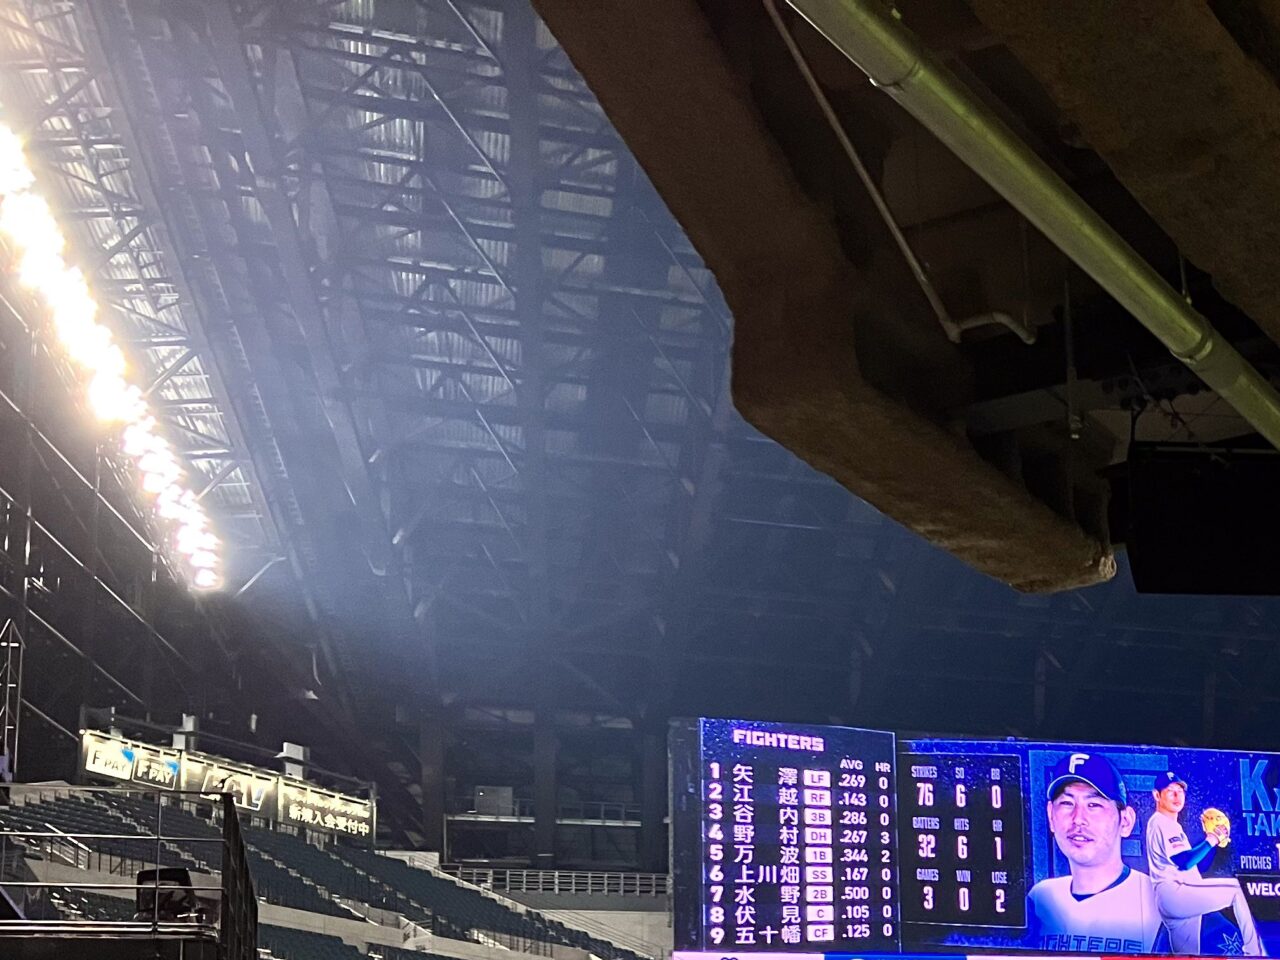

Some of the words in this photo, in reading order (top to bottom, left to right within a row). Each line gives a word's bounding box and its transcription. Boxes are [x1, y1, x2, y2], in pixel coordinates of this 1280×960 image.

[733, 729, 824, 751] FIGHTERS
[839, 759, 863, 771] AVG
[875, 762, 891, 773] HR
[838, 775, 866, 788] .269
[733, 784, 798, 805] 江越
[838, 793, 867, 806] .143
[916, 783, 934, 807] 76
[955, 784, 967, 808] 6
[991, 785, 1002, 809] 0
[733, 804, 798, 825] 谷内
[839, 811, 867, 825] .286
[734, 825, 799, 845] 野村
[839, 831, 868, 844] .267
[734, 845, 800, 865] 万波
[840, 850, 868, 863] .344
[918, 834, 936, 858] 32
[957, 835, 968, 859] 6
[994, 837, 1002, 861] 1
[1240, 855, 1272, 870] PITCHES
[734, 865, 800, 885] 上川畑
[840, 868, 869, 881] .167
[956, 870, 971, 883] WIN
[991, 871, 1007, 884] LOSE
[735, 886, 801, 904] 水野
[841, 887, 869, 900] .500
[923, 885, 934, 910] 3
[959, 887, 969, 911] 0
[995, 888, 1006, 913] 2
[735, 906, 801, 925] 伏見
[841, 905, 870, 919] .105
[842, 925, 870, 939] .125
